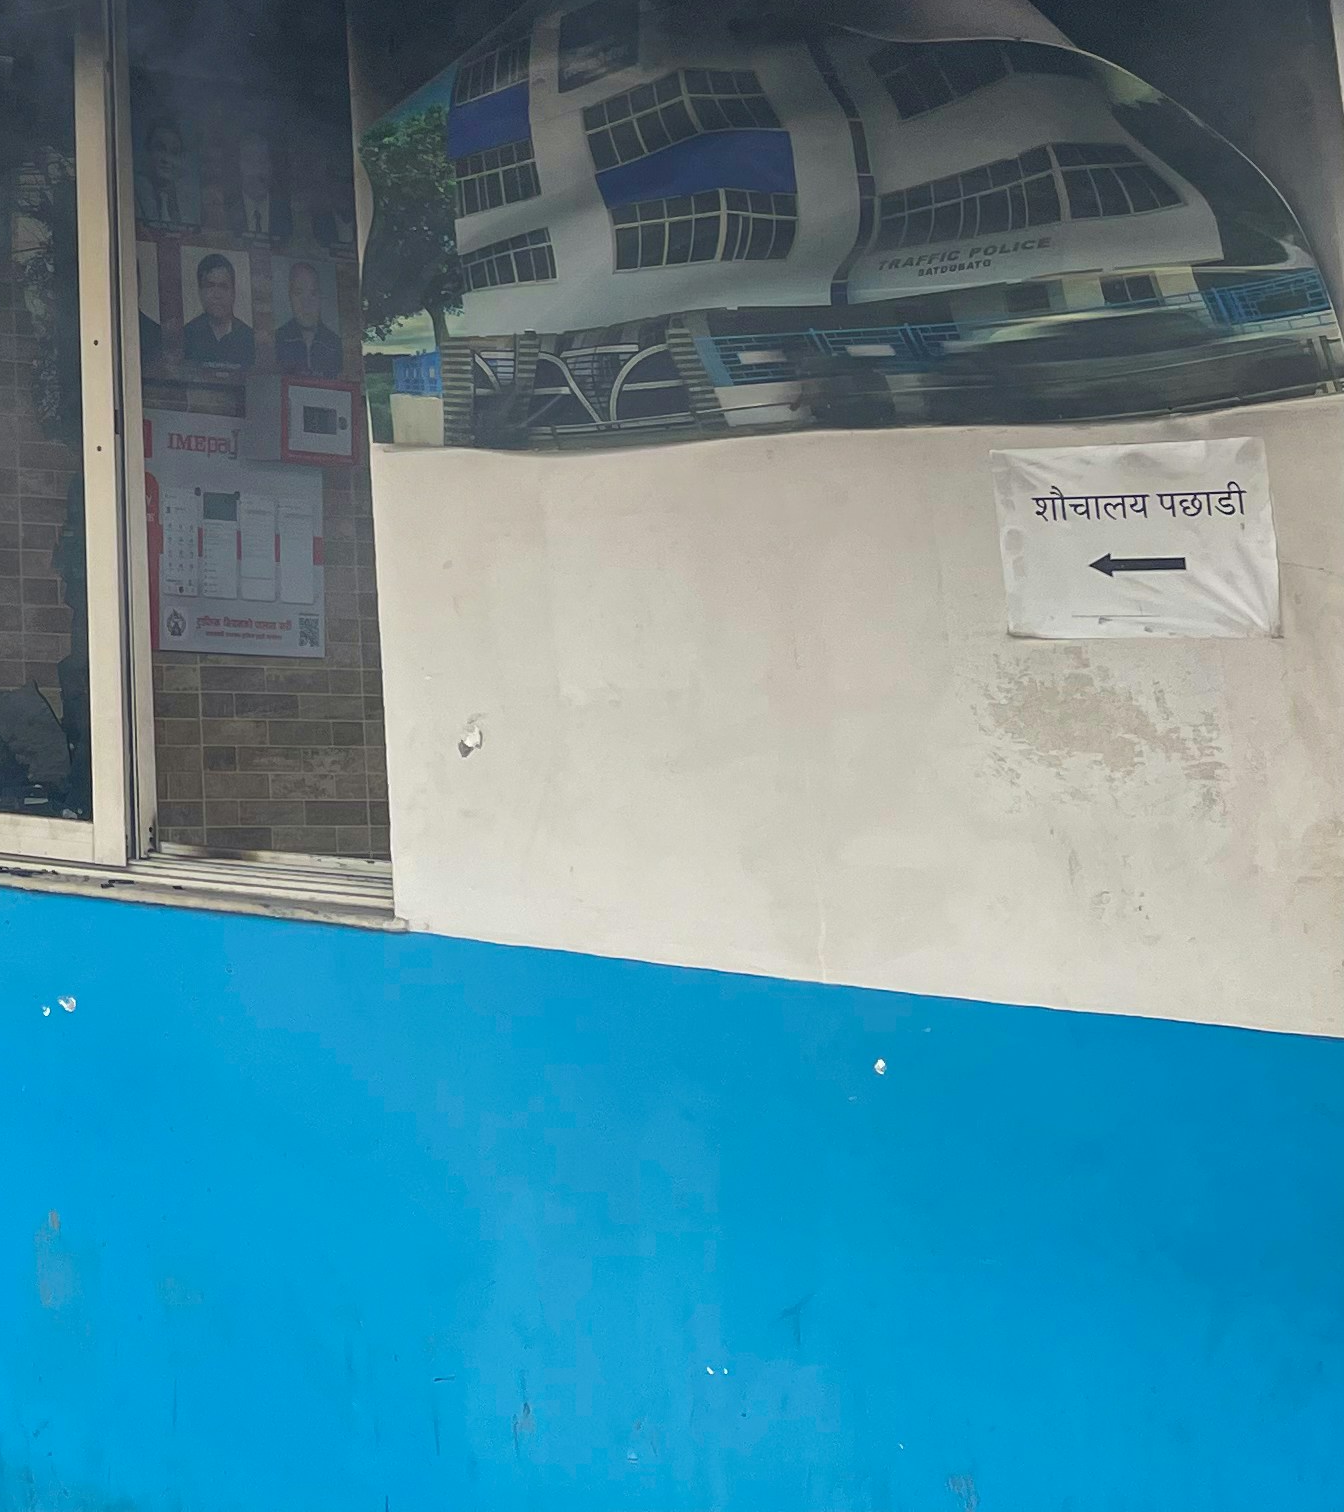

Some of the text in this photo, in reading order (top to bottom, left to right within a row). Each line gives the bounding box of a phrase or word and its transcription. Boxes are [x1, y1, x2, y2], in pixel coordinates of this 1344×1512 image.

[878, 237, 1053, 272] TRAFFIC POLICE
[1031, 481, 1248, 522] शौचालय पछाडी
